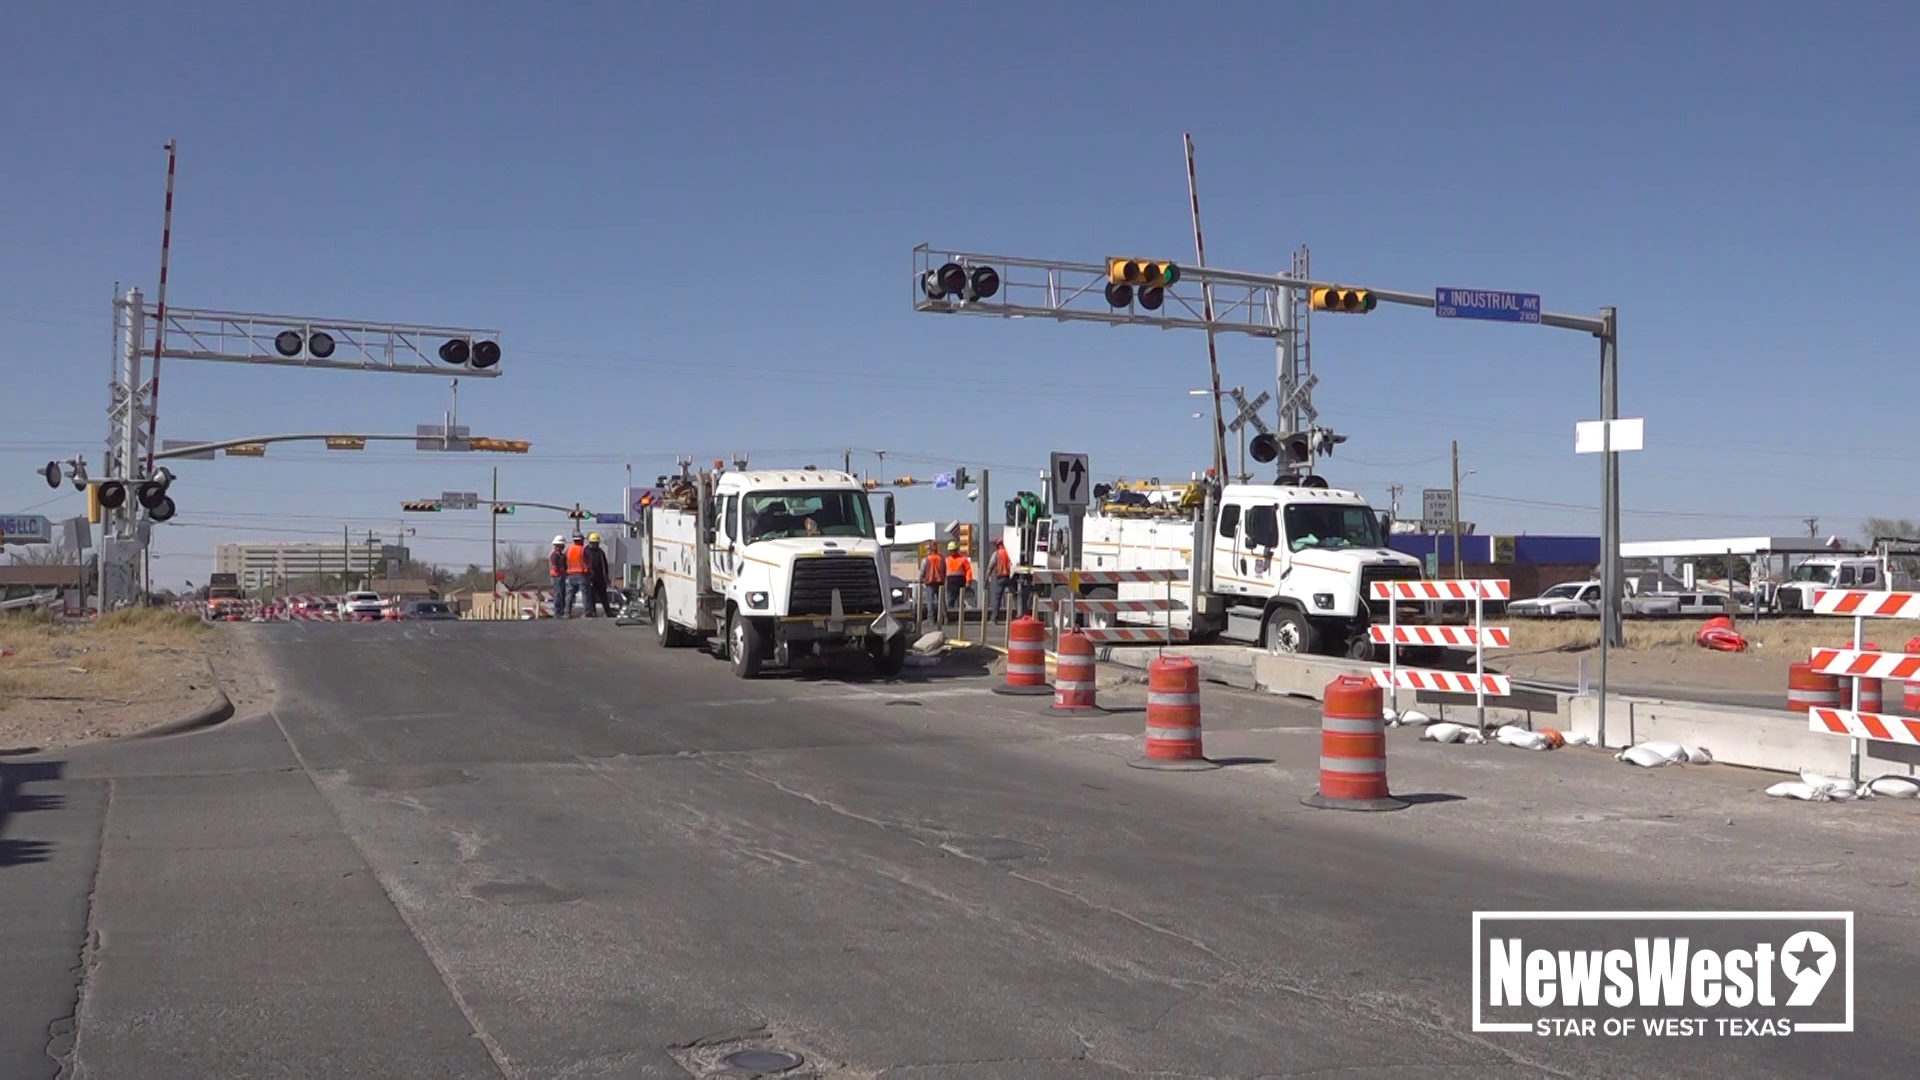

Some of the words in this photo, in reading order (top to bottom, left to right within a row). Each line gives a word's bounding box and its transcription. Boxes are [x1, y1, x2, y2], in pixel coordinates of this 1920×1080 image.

[1437, 291, 1446, 303] W
[1451, 291, 1521, 310] INDUSTRIAL
[1438, 305, 1457, 317] 2200
[1519, 311, 1539, 323] 2100
[1280, 374, 1319, 417] CROSSING
[1229, 391, 1270, 432] CROSSING
[1430, 502, 1447, 510] STOP
[1425, 519, 1451, 527] TRACKS
